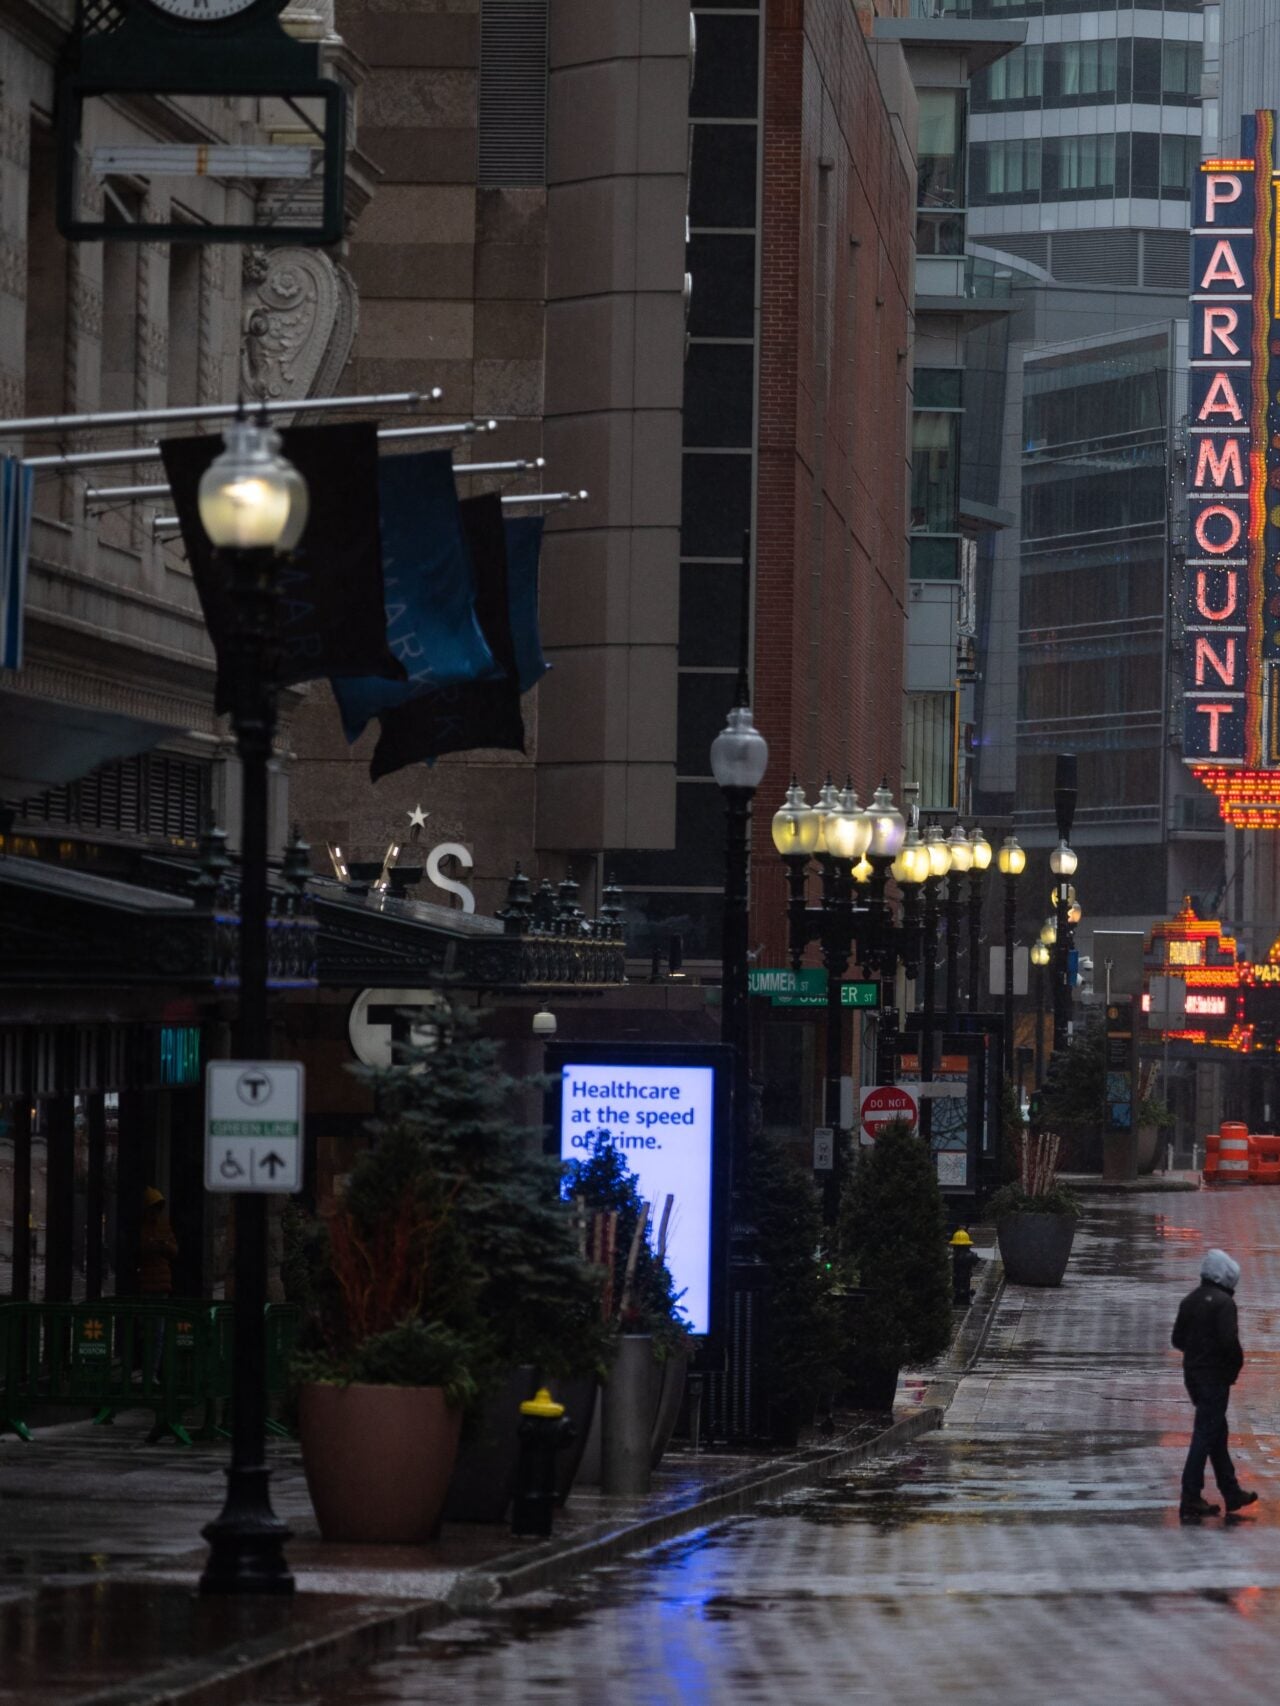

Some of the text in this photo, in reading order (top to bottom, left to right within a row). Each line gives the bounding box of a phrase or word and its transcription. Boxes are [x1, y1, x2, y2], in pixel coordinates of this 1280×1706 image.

[1194, 172, 1247, 753] PARAMOUNT
[572, 1080, 680, 1100] Healthcare
[870, 1098, 907, 1109] DO NOT
[571, 1105, 695, 1129] at the speed
